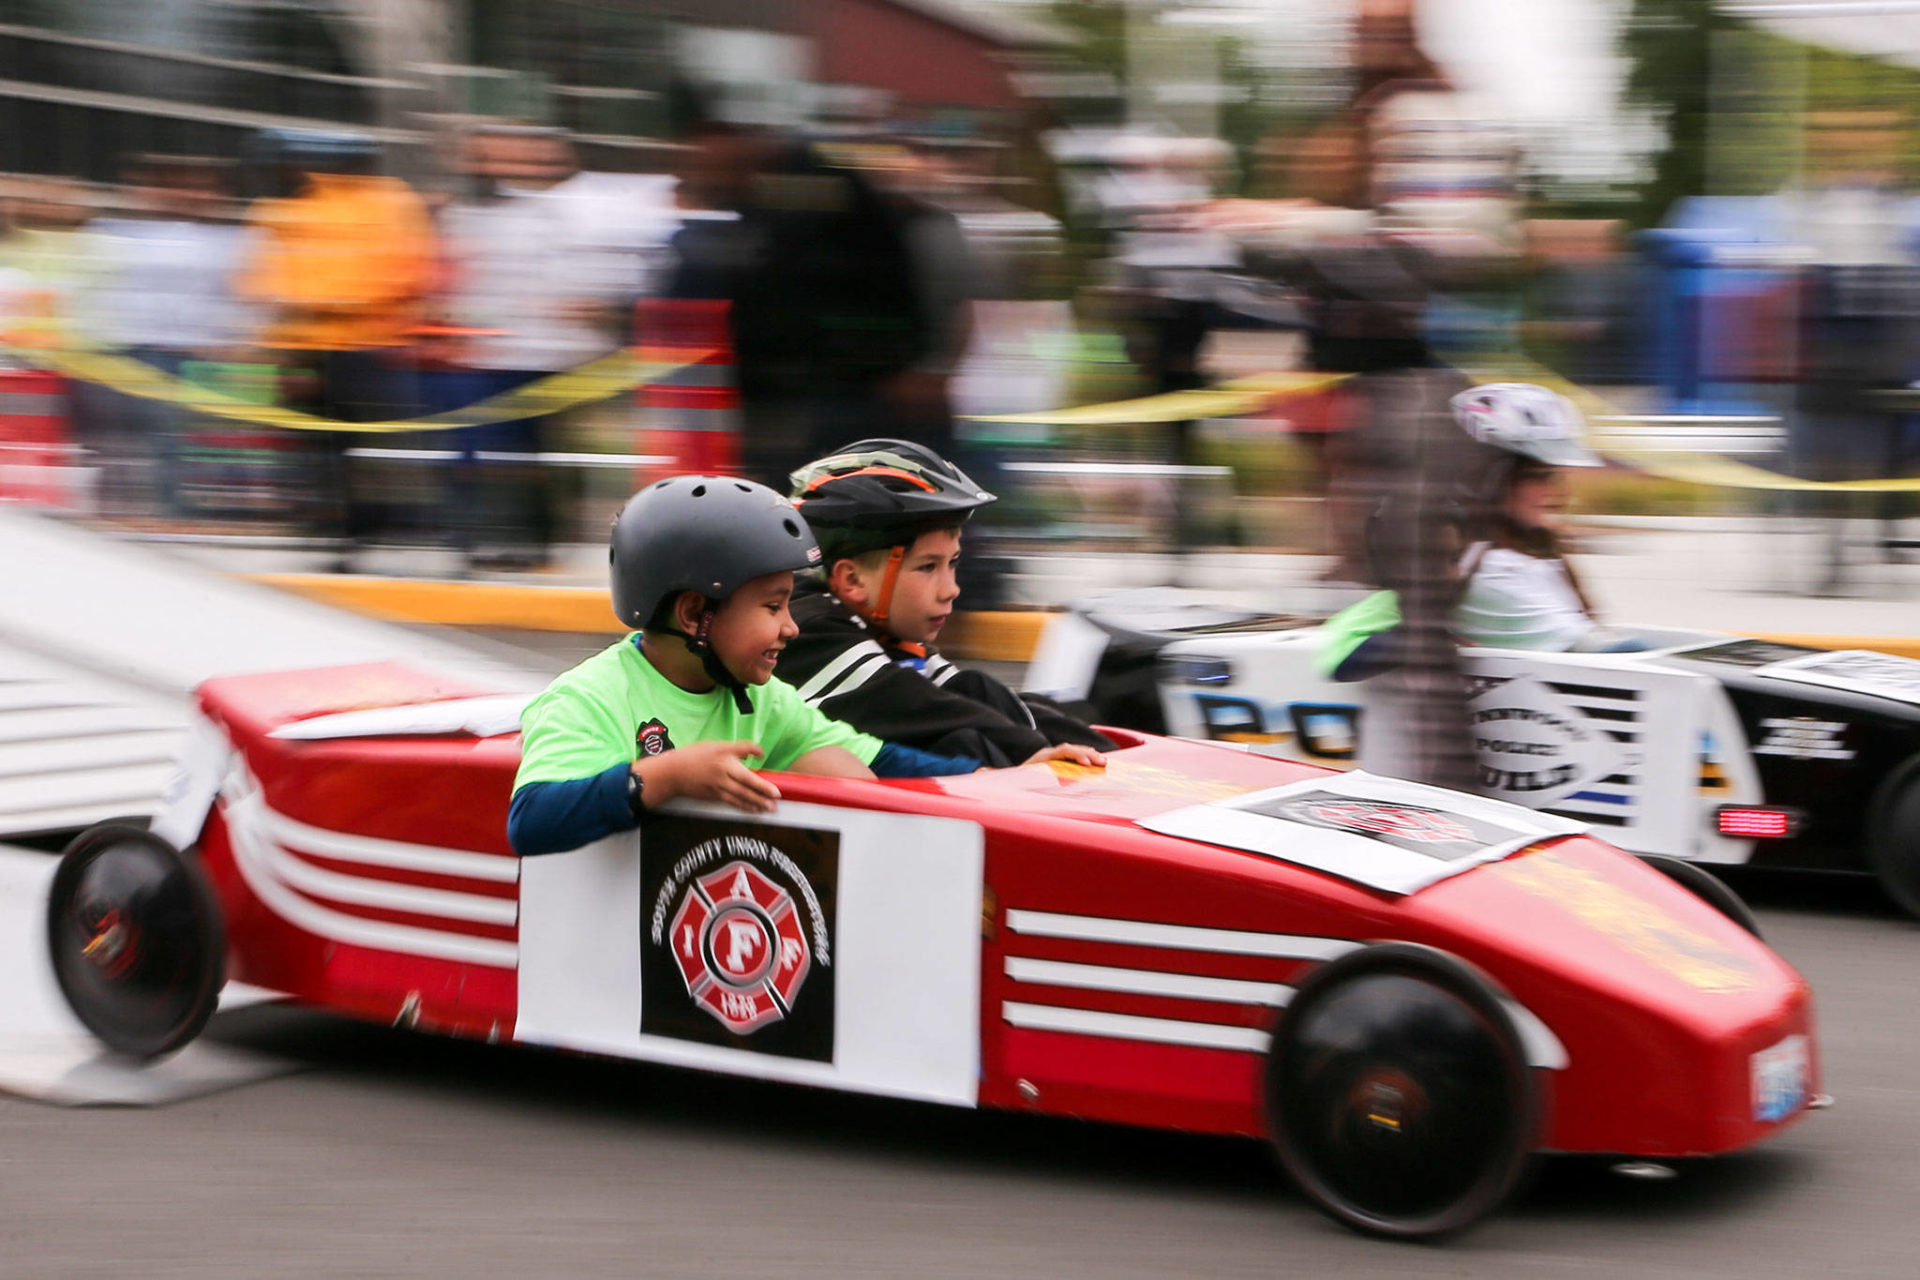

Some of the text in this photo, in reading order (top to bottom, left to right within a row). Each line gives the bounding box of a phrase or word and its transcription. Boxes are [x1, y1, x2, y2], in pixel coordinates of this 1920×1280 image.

[1478, 762, 1580, 792] UILD
[674, 838, 722, 884] COUNTY
[725, 836, 769, 861] UNION
[729, 866, 756, 900] A
[725, 920, 762, 972] F
[780, 936, 803, 971] F
